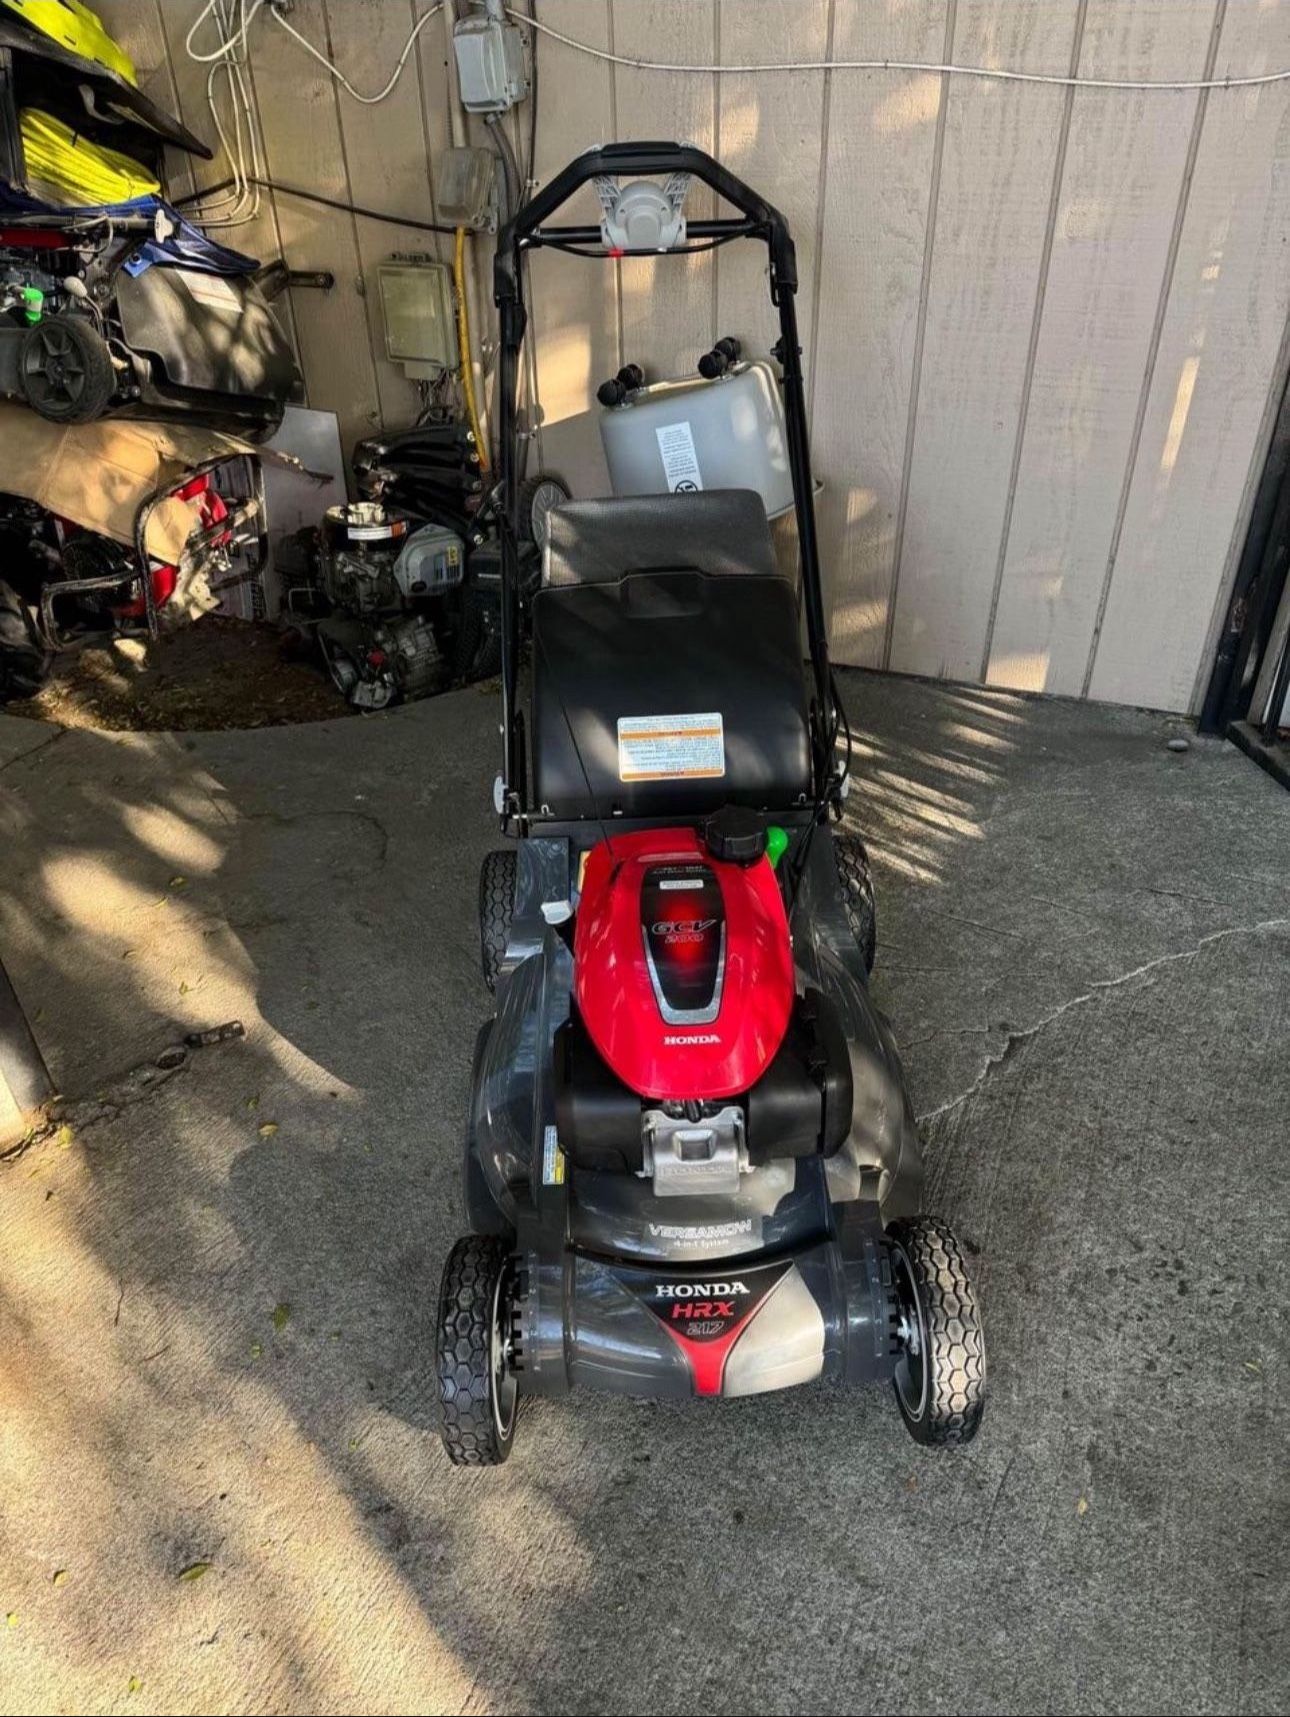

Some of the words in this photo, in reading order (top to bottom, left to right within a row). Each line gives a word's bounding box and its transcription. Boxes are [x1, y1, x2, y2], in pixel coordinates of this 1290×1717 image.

[652, 919, 717, 935] GCV
[663, 1034, 721, 1046] HONDA
[649, 1219, 752, 1239] VERSAMOW
[656, 1281, 751, 1298] HONDA
[671, 1301, 736, 1318] HRX
[687, 1321, 725, 1336] 217
